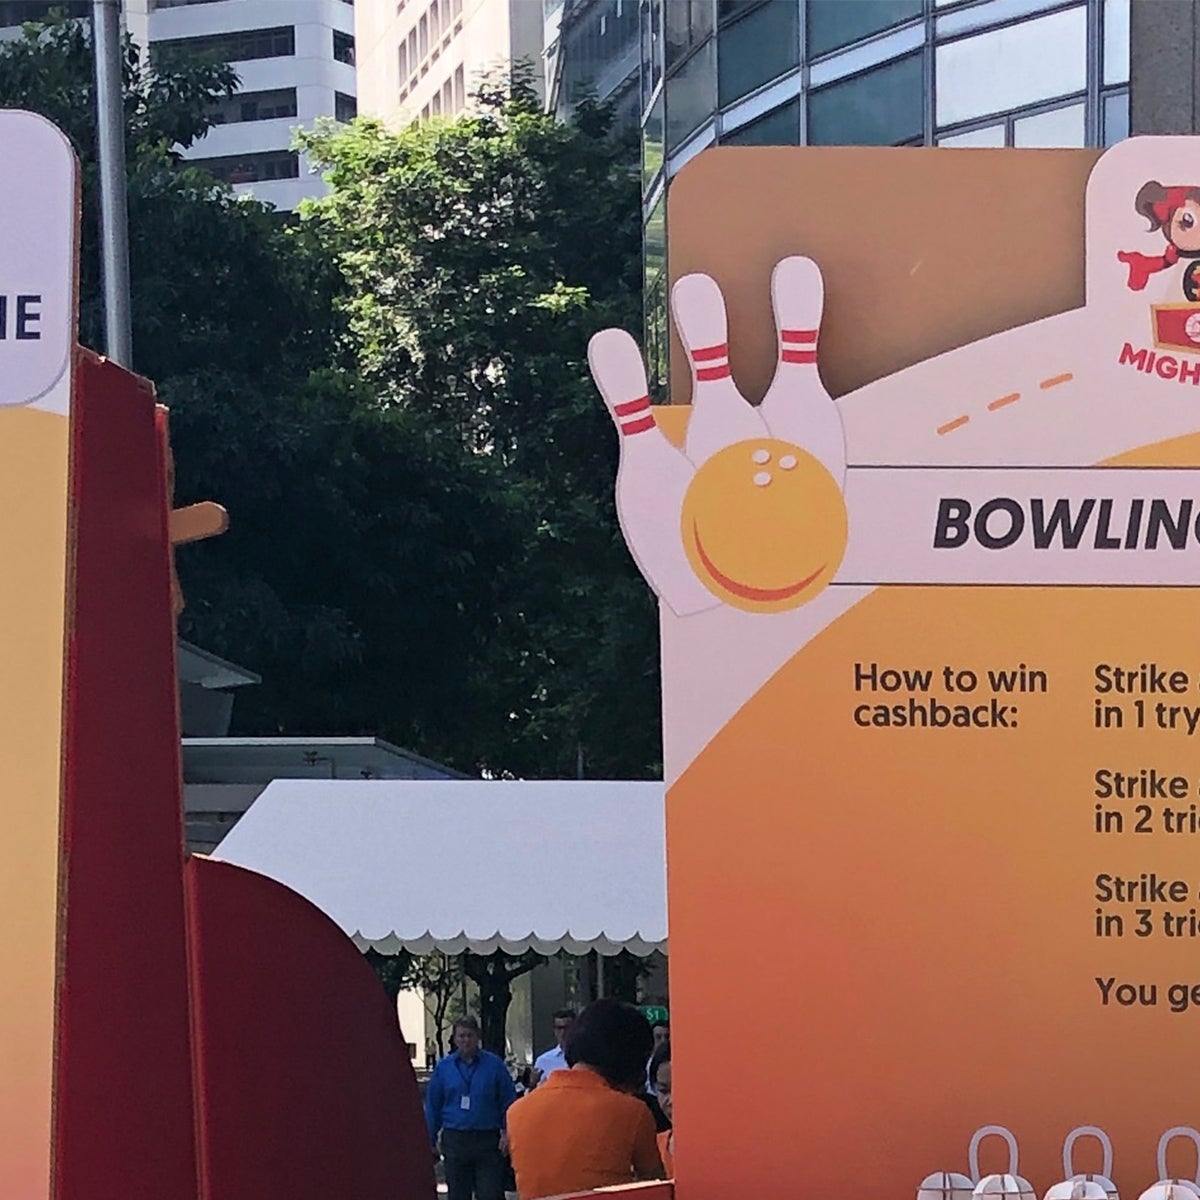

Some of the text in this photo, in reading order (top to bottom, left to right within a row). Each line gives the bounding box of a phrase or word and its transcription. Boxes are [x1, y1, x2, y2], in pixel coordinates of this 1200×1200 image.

[855, 664, 1046, 692] How to win
[1095, 664, 1188, 693] Strike
[855, 698, 1017, 727] cashback:
[1095, 699, 1122, 727] in
[1135, 701, 1143, 727] 1
[1156, 703, 1200, 735] try
[1095, 770, 1188, 798] Strike
[1096, 804, 1122, 832] in
[1135, 805, 1152, 832] 2
[1096, 874, 1188, 902] Strike
[1096, 908, 1122, 936] in
[1135, 910, 1152, 936] 3
[1095, 978, 1156, 1005] You
